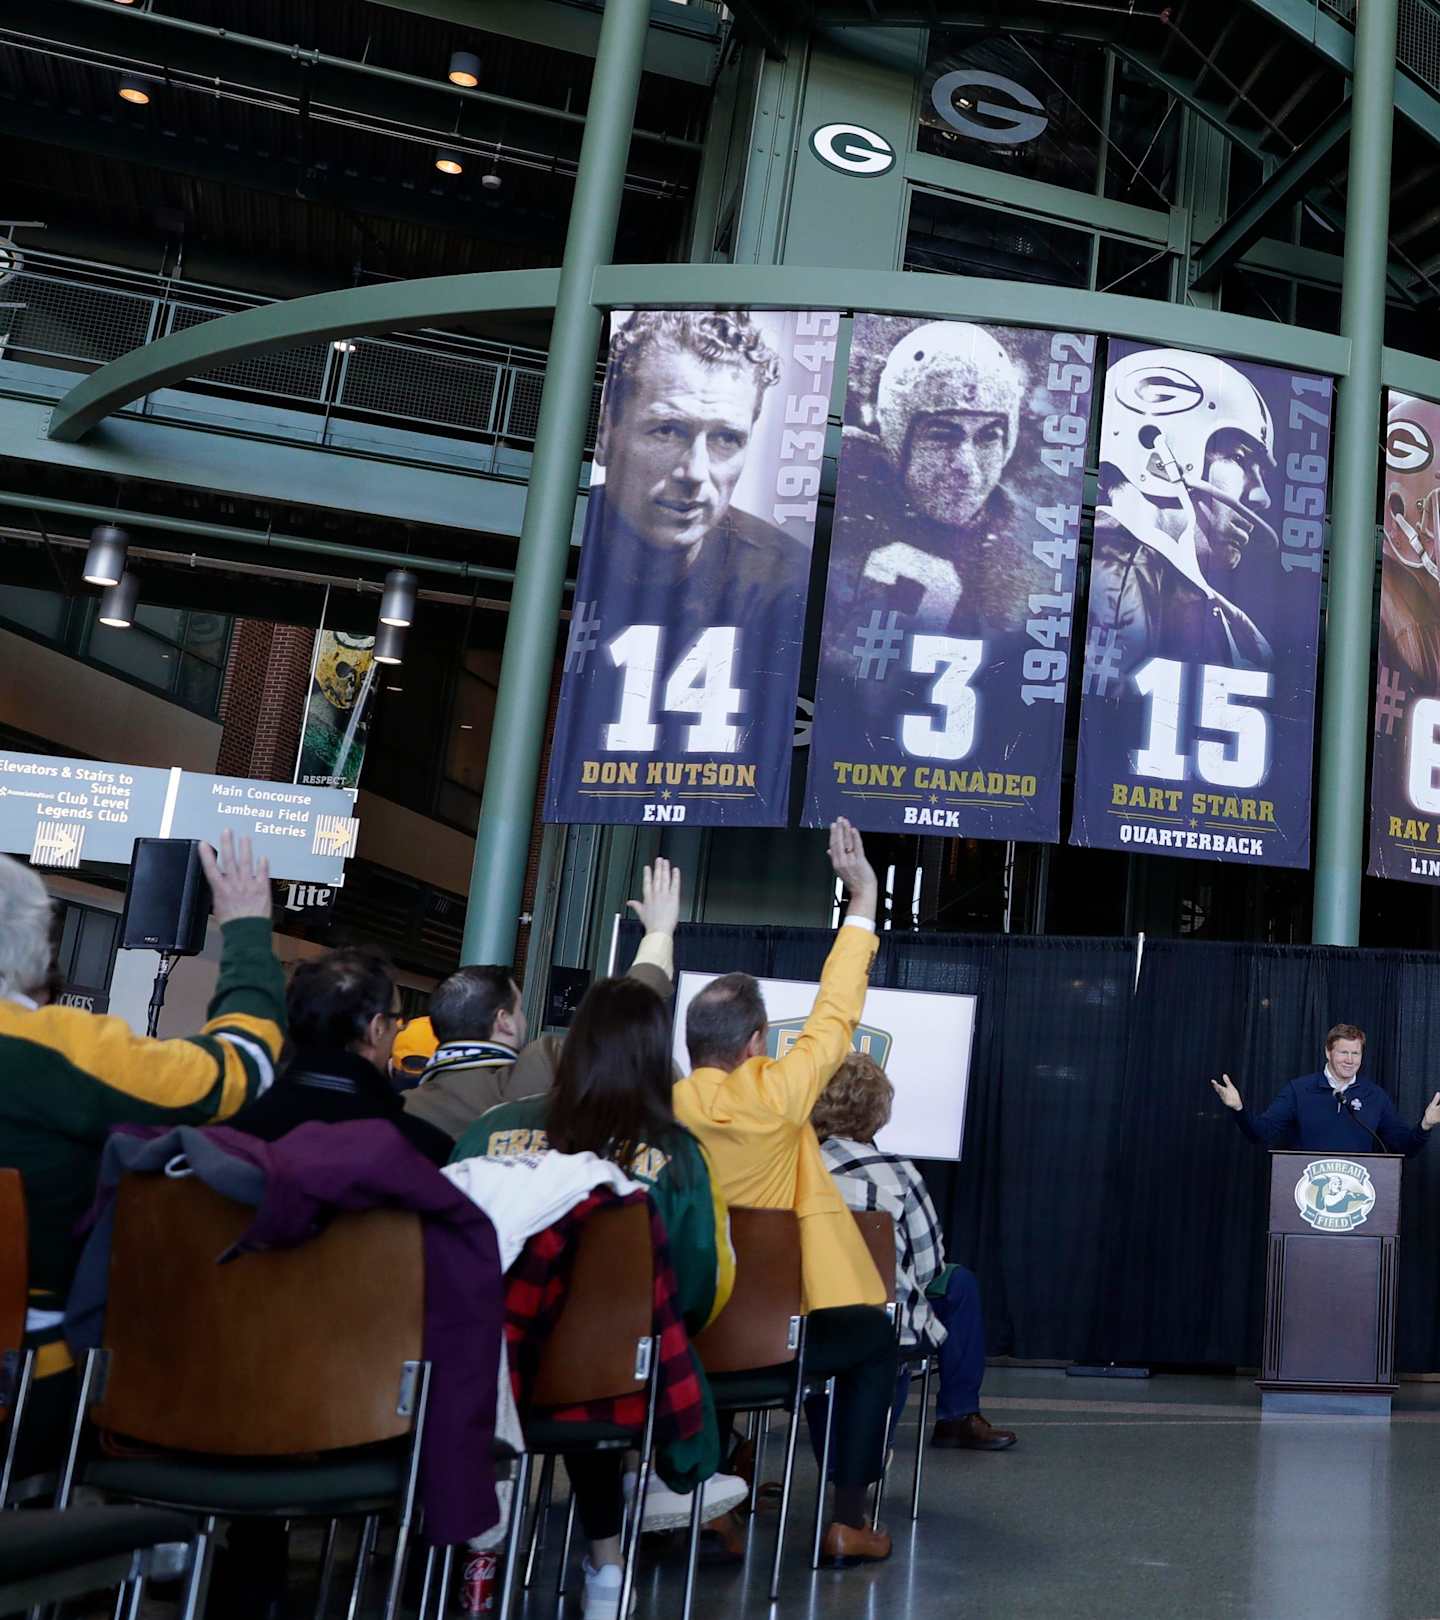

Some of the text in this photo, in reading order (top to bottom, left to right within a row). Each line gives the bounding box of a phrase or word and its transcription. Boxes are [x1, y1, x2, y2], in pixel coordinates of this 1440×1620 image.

[813, 123, 894, 174] G
[773, 311, 840, 525] 1935-45
[1281, 376, 1331, 573] 1956-71
[1021, 332, 1095, 706] 1941-44 46-52
[607, 625, 741, 753] 14
[903, 634, 984, 760] 3
[1135, 657, 1268, 788] 15
[61, 766, 72, 778] &
[75, 768, 115, 783] Stairs
[119, 773, 134, 785] to
[302, 775, 347, 786] RESPECT
[581, 761, 757, 787] DON HUTSON
[833, 761, 1037, 797] TONY CANADEO
[57, 791, 88, 806] Club
[93, 796, 129, 810] Level
[90, 783, 131, 797] Suites
[212, 783, 312, 805] Main Concourse
[1111, 783, 1276, 822] BART STARR
[36, 803, 128, 823] Legends Club
[217, 802, 310, 823] Lambeau Field
[643, 804, 686, 822] END
[904, 807, 960, 828] BACK
[254, 821, 307, 838] Eateries
[1119, 824, 1263, 855] QUARTERBACK
[1388, 816, 1431, 842] RAY
[284, 883, 332, 912] Lite
[60, 993, 95, 1012] CKETS
[486, 1129, 550, 1157] GRE
[1312, 1162, 1361, 1177] LAMBEAU
[1316, 1216, 1349, 1228] FIELD
